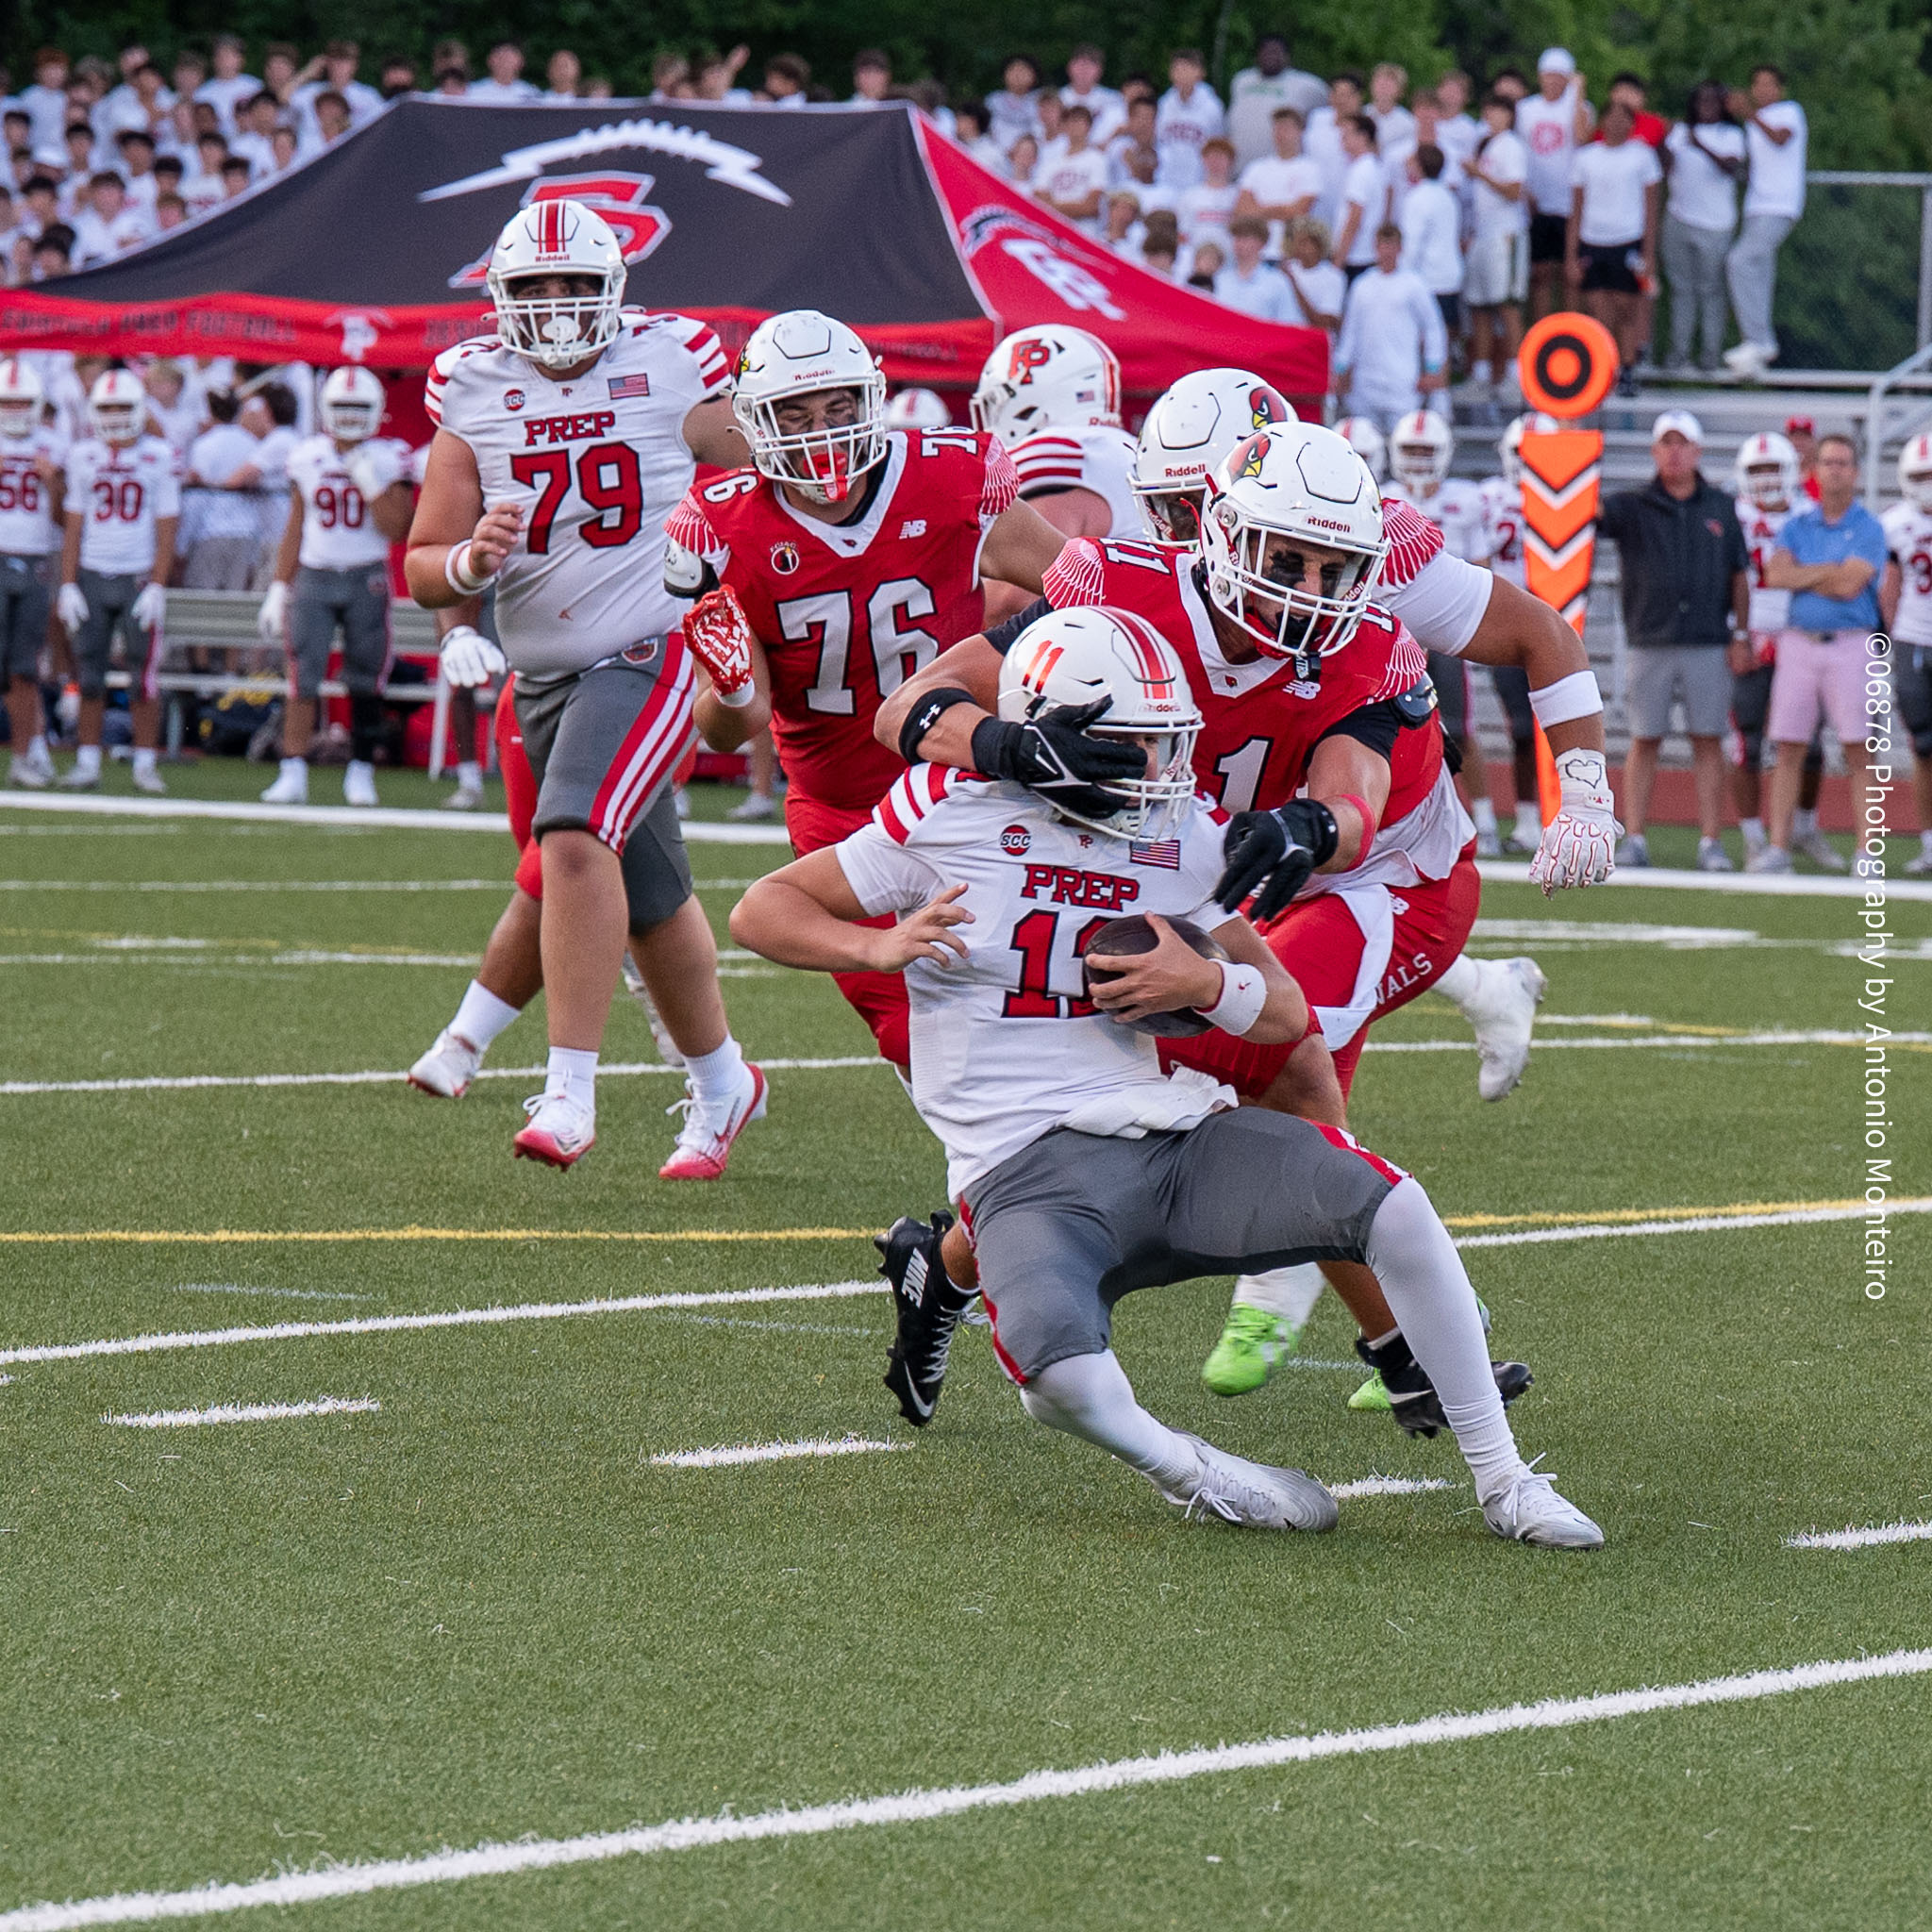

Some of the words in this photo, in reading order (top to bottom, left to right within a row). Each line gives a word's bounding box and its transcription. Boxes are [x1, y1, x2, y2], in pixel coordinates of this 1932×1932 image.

[524, 410, 616, 446] PREP
[1165, 464, 1207, 477] Riddell
[93, 481, 143, 522] 30
[315, 487, 364, 528] 90
[509, 441, 643, 555] 79
[775, 575, 940, 716] 76
[1022, 640, 1064, 694] 11
[1000, 832, 1031, 847] SCC
[1021, 863, 1140, 912] PREP
[901, 1247, 929, 1309] NIKE
